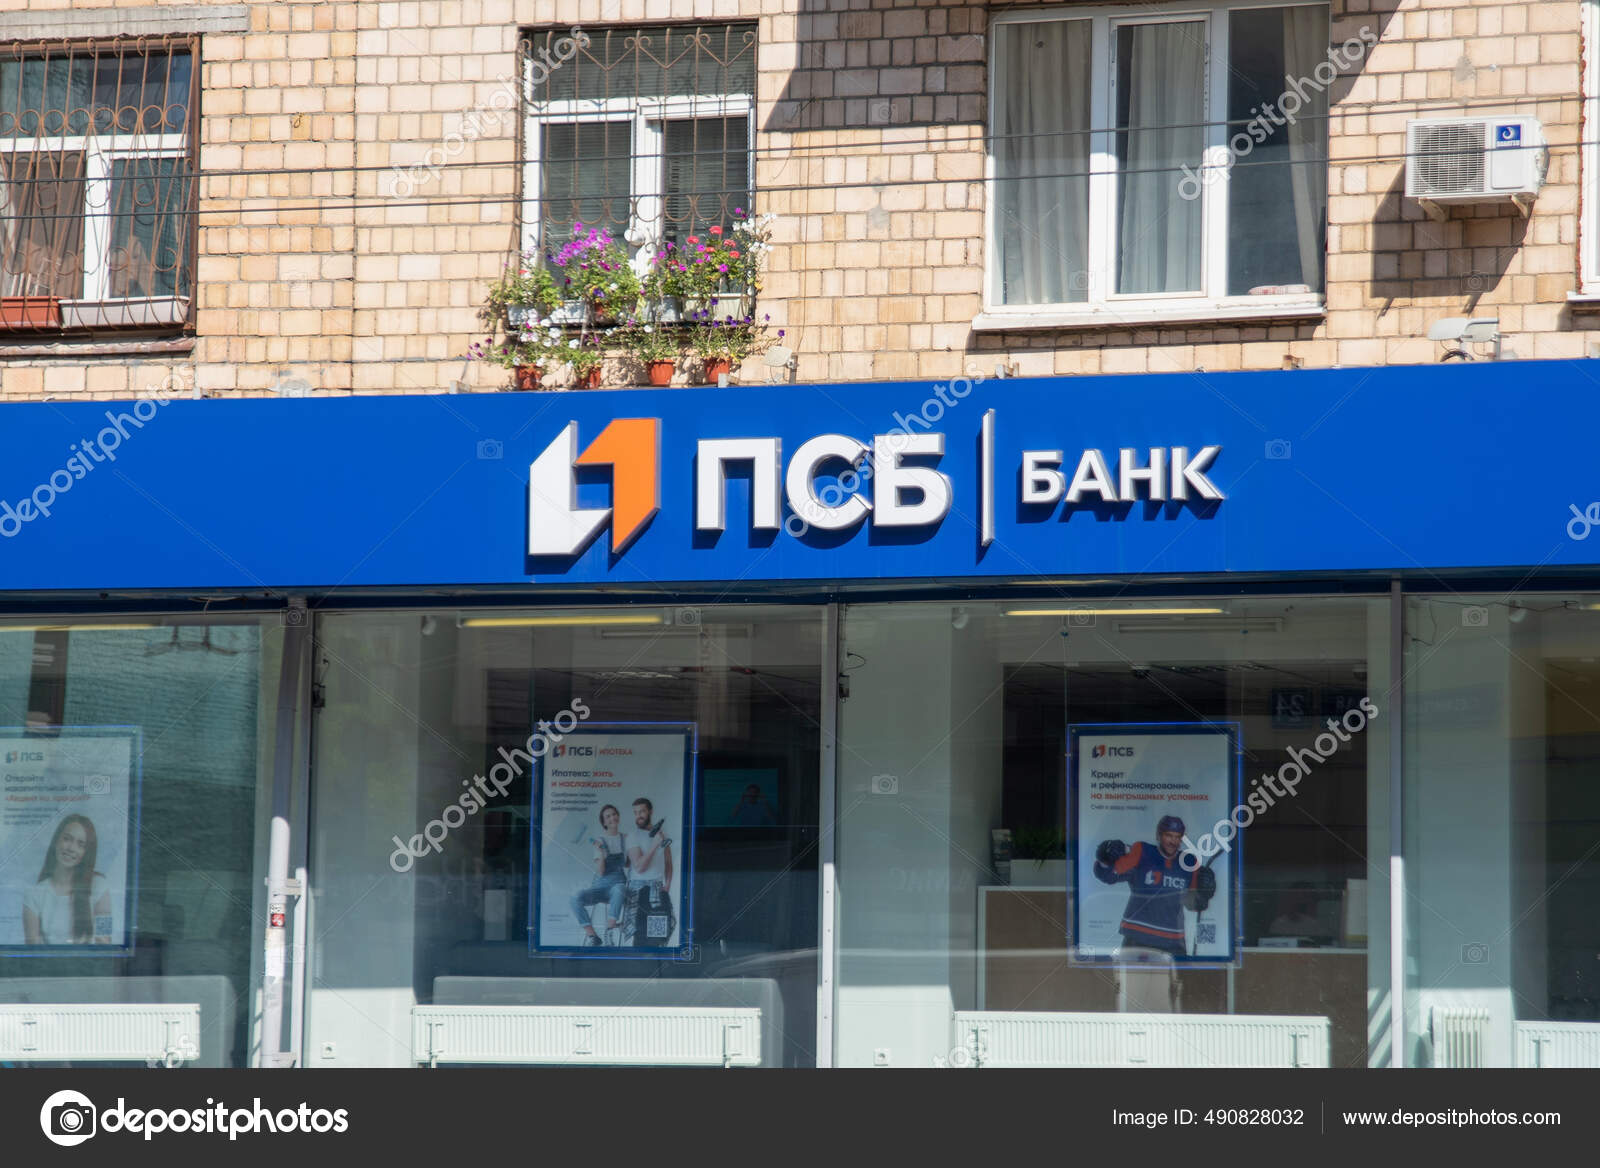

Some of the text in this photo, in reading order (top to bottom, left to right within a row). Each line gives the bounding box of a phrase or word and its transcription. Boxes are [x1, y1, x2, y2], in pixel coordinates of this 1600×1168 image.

[696, 432, 1225, 531] ПСБ БАНК
[20, 751, 44, 761] ПСБ
[568, 746, 633, 756] ПСБ ИПОТЕКА
[1108, 746, 1134, 757] ПСБ
[551, 768, 591, 778] Ипотека:
[1090, 770, 1124, 779] Кредит
[1099, 780, 1191, 790] рефинансирование
[1167, 794, 1210, 802] условиях
